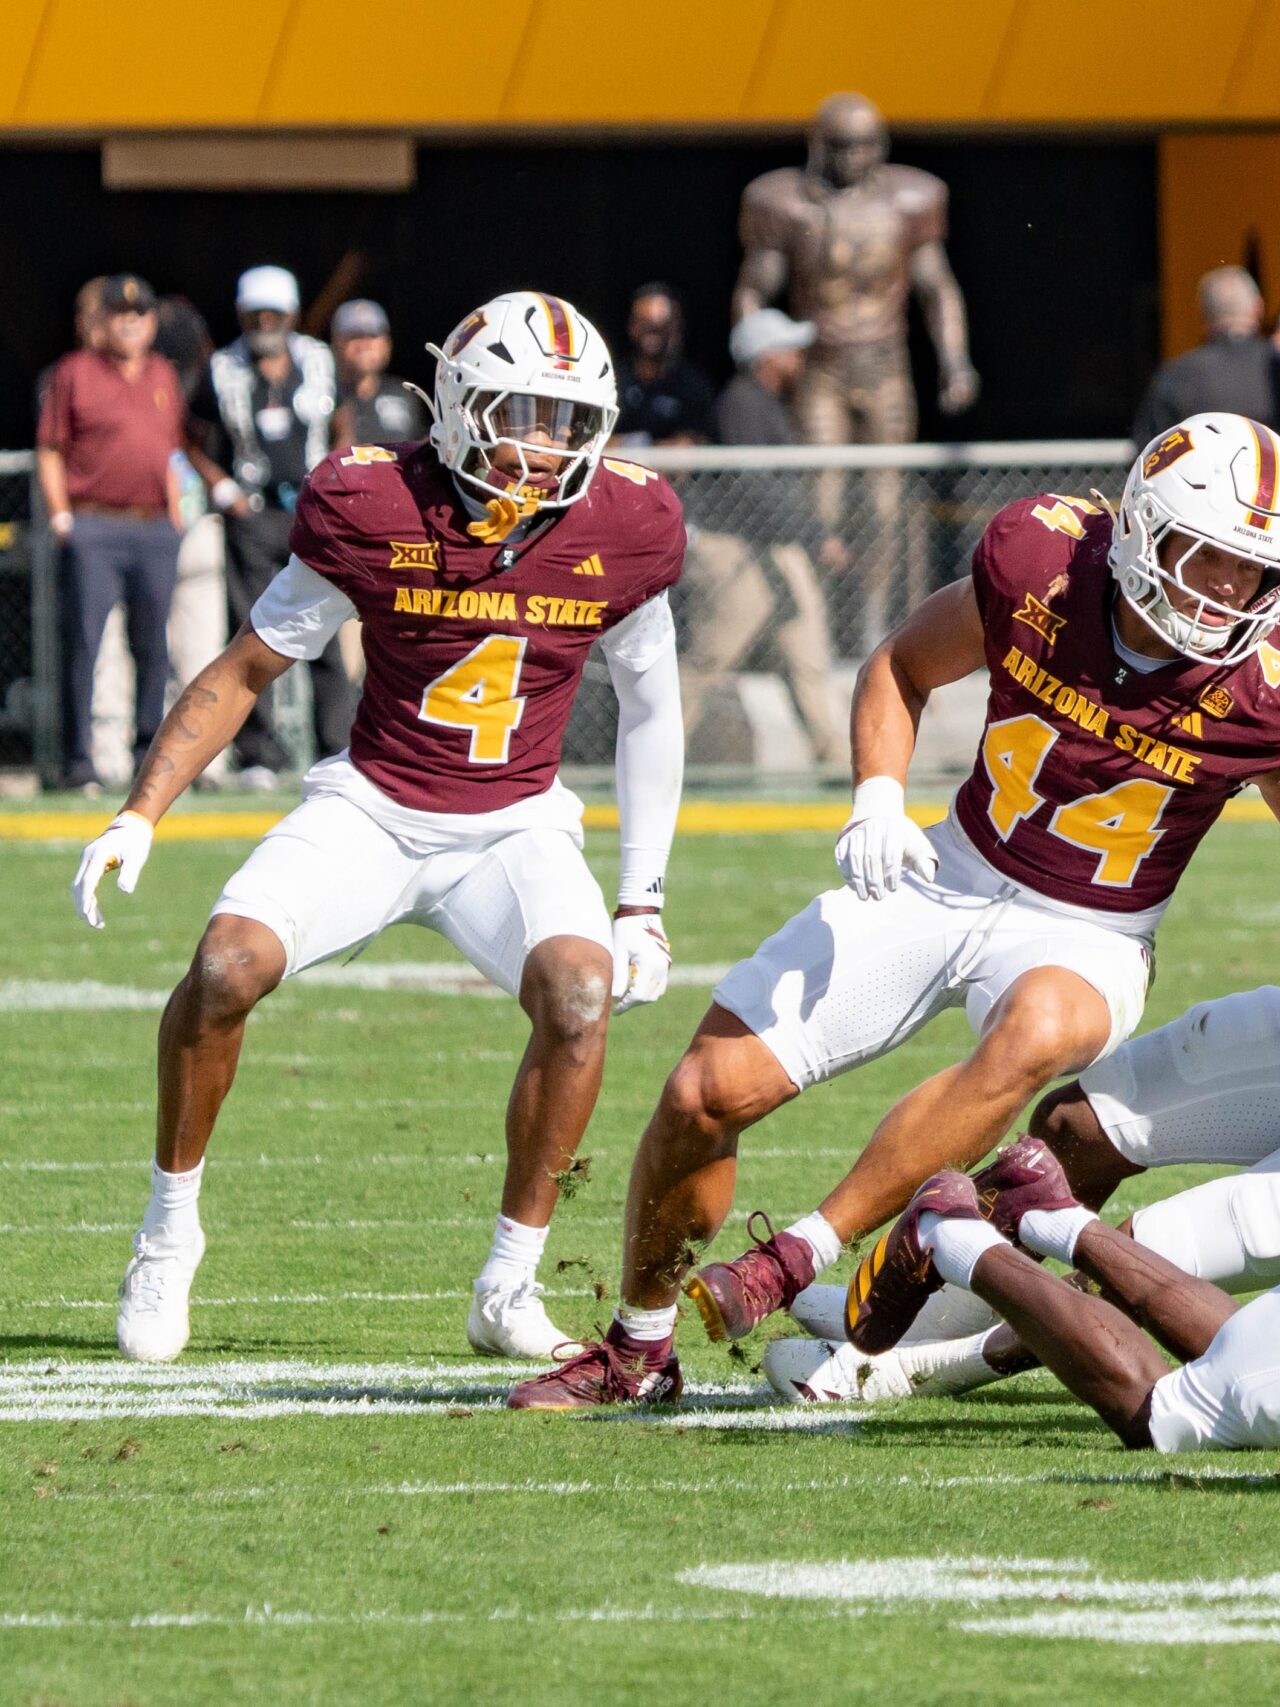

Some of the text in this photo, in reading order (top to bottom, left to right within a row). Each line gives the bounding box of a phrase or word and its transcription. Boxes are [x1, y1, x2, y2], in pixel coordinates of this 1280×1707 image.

[541, 371, 581, 383] ARIZONA STATE
[1233, 525, 1274, 544] ARIZONA STATE
[394, 587, 609, 625] ARIZONA STATE
[418, 633, 528, 764] 4
[1002, 646, 1111, 738] ARIZONA
[1113, 723, 1203, 784] STATE
[983, 713, 1175, 887] 44
